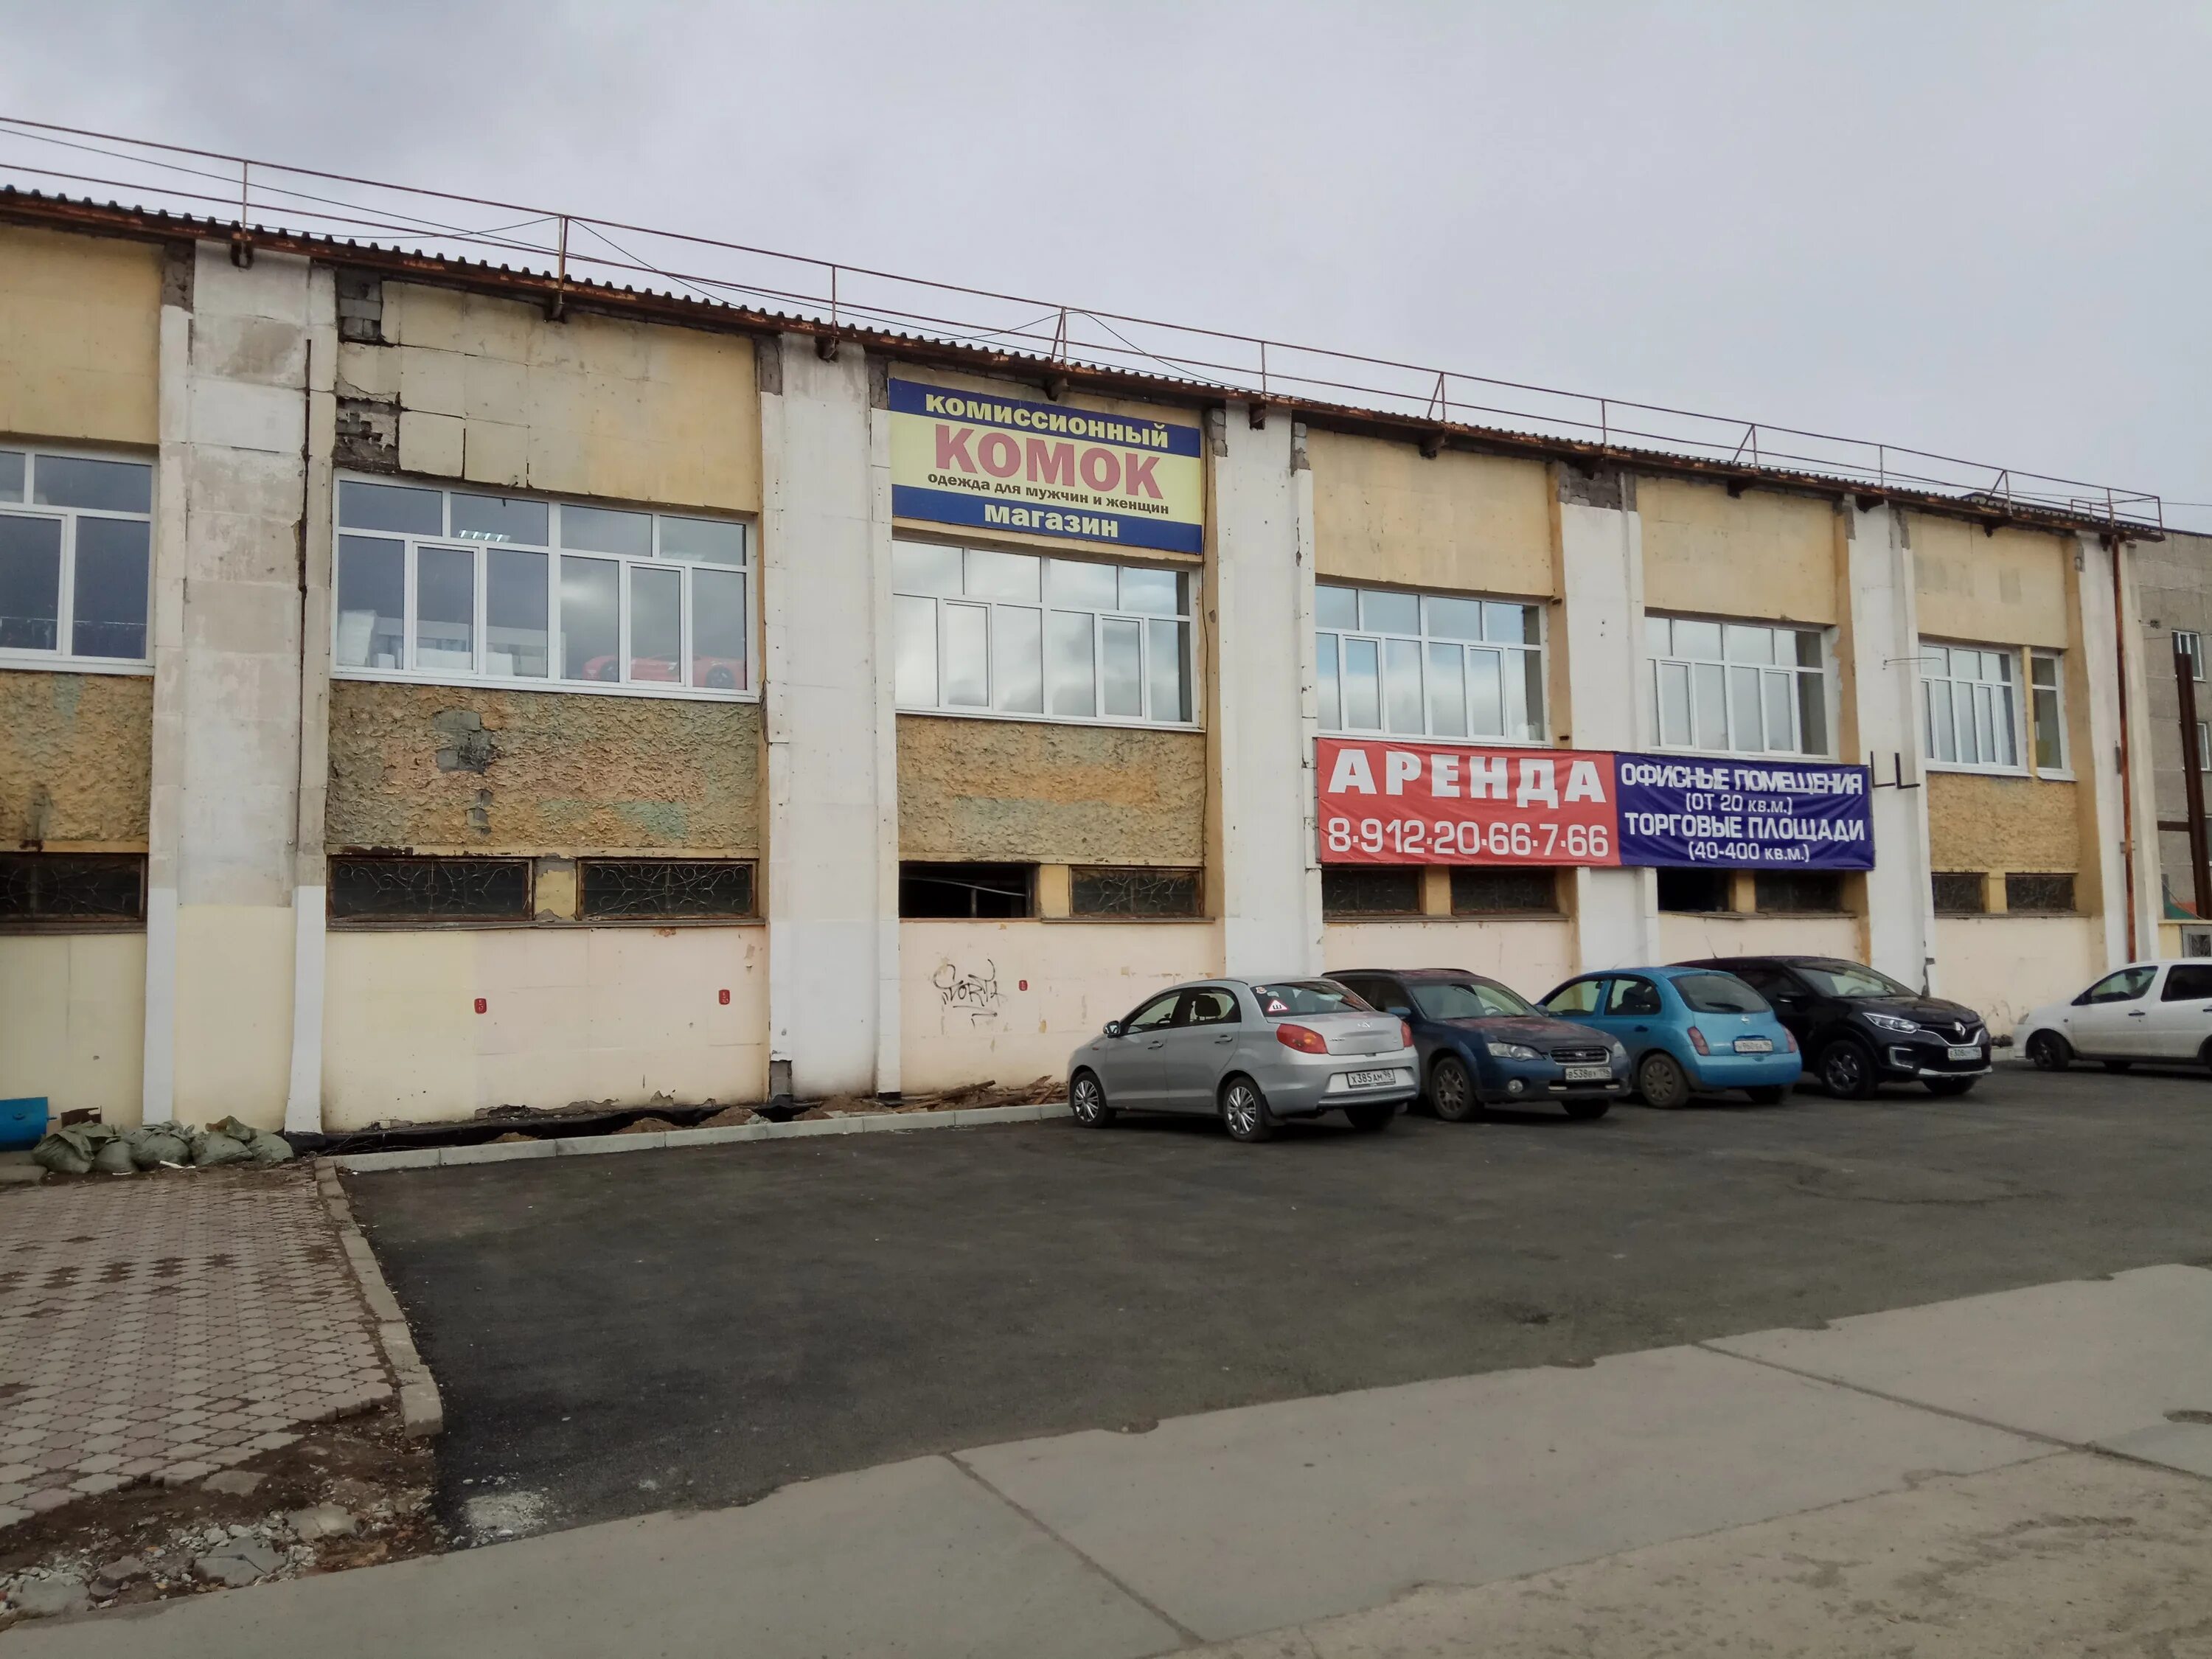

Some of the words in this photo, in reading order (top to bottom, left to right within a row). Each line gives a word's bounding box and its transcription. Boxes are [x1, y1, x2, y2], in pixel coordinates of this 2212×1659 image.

[935, 423, 1164, 500] КОМОК
[927, 472, 990, 491] одежда
[994, 483, 1021, 495] для
[1026, 487, 1089, 504] мужчин
[1093, 495, 1102, 505] и
[1106, 498, 1169, 515] женщин
[1328, 748, 1607, 809] АРЕНДА
[1734, 770, 1863, 796] ПОМЕЩЕНИЯ
[1686, 793, 1714, 812] (ОТ
[1720, 795, 1743, 812] 20
[1624, 813, 1742, 839] ТОРГОВЫЕ
[1748, 817, 1865, 842] ПЛОЩАДИ
[1688, 841, 1760, 860] (40-400
